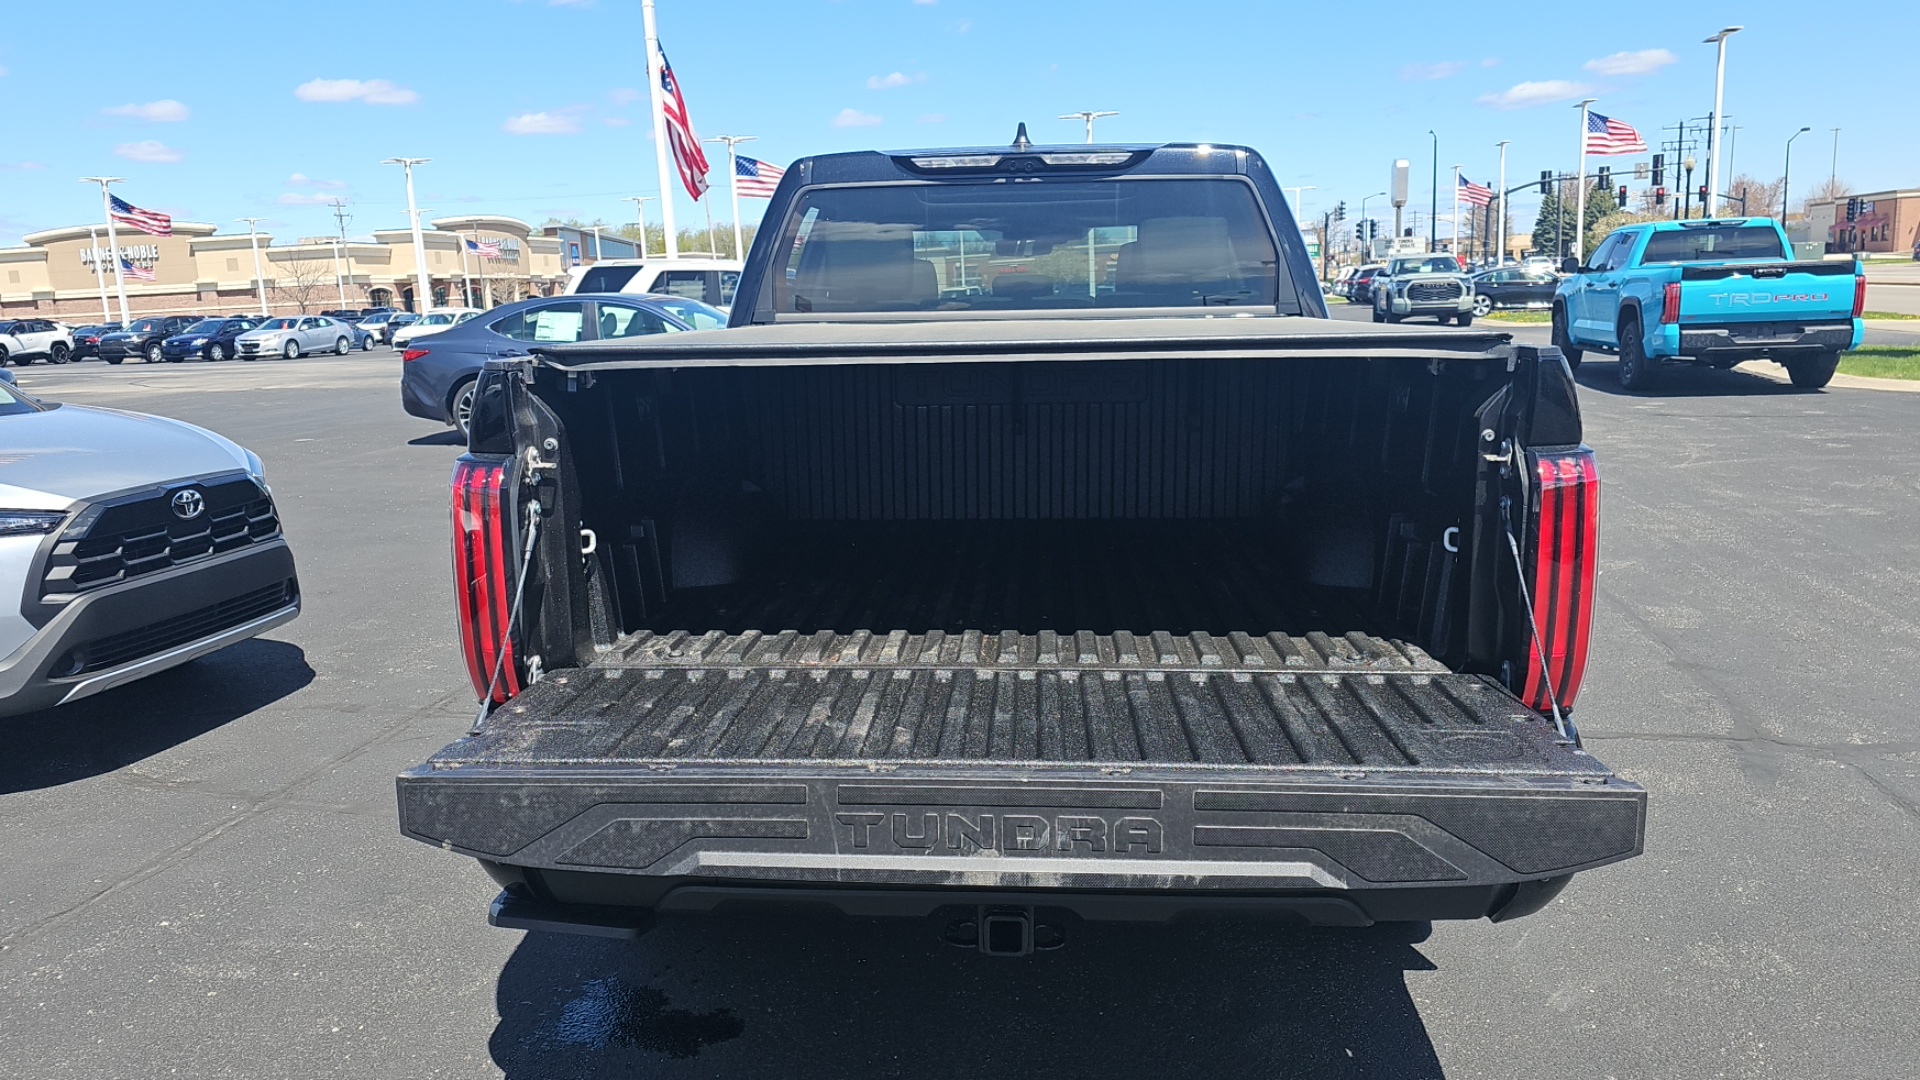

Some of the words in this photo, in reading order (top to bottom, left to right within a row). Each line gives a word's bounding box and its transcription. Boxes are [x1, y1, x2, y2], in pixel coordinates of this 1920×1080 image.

[128, 244, 158, 261] NOBLE
[1773, 293, 1829, 303] PRO
[835, 812, 1164, 853] TUNDRA
